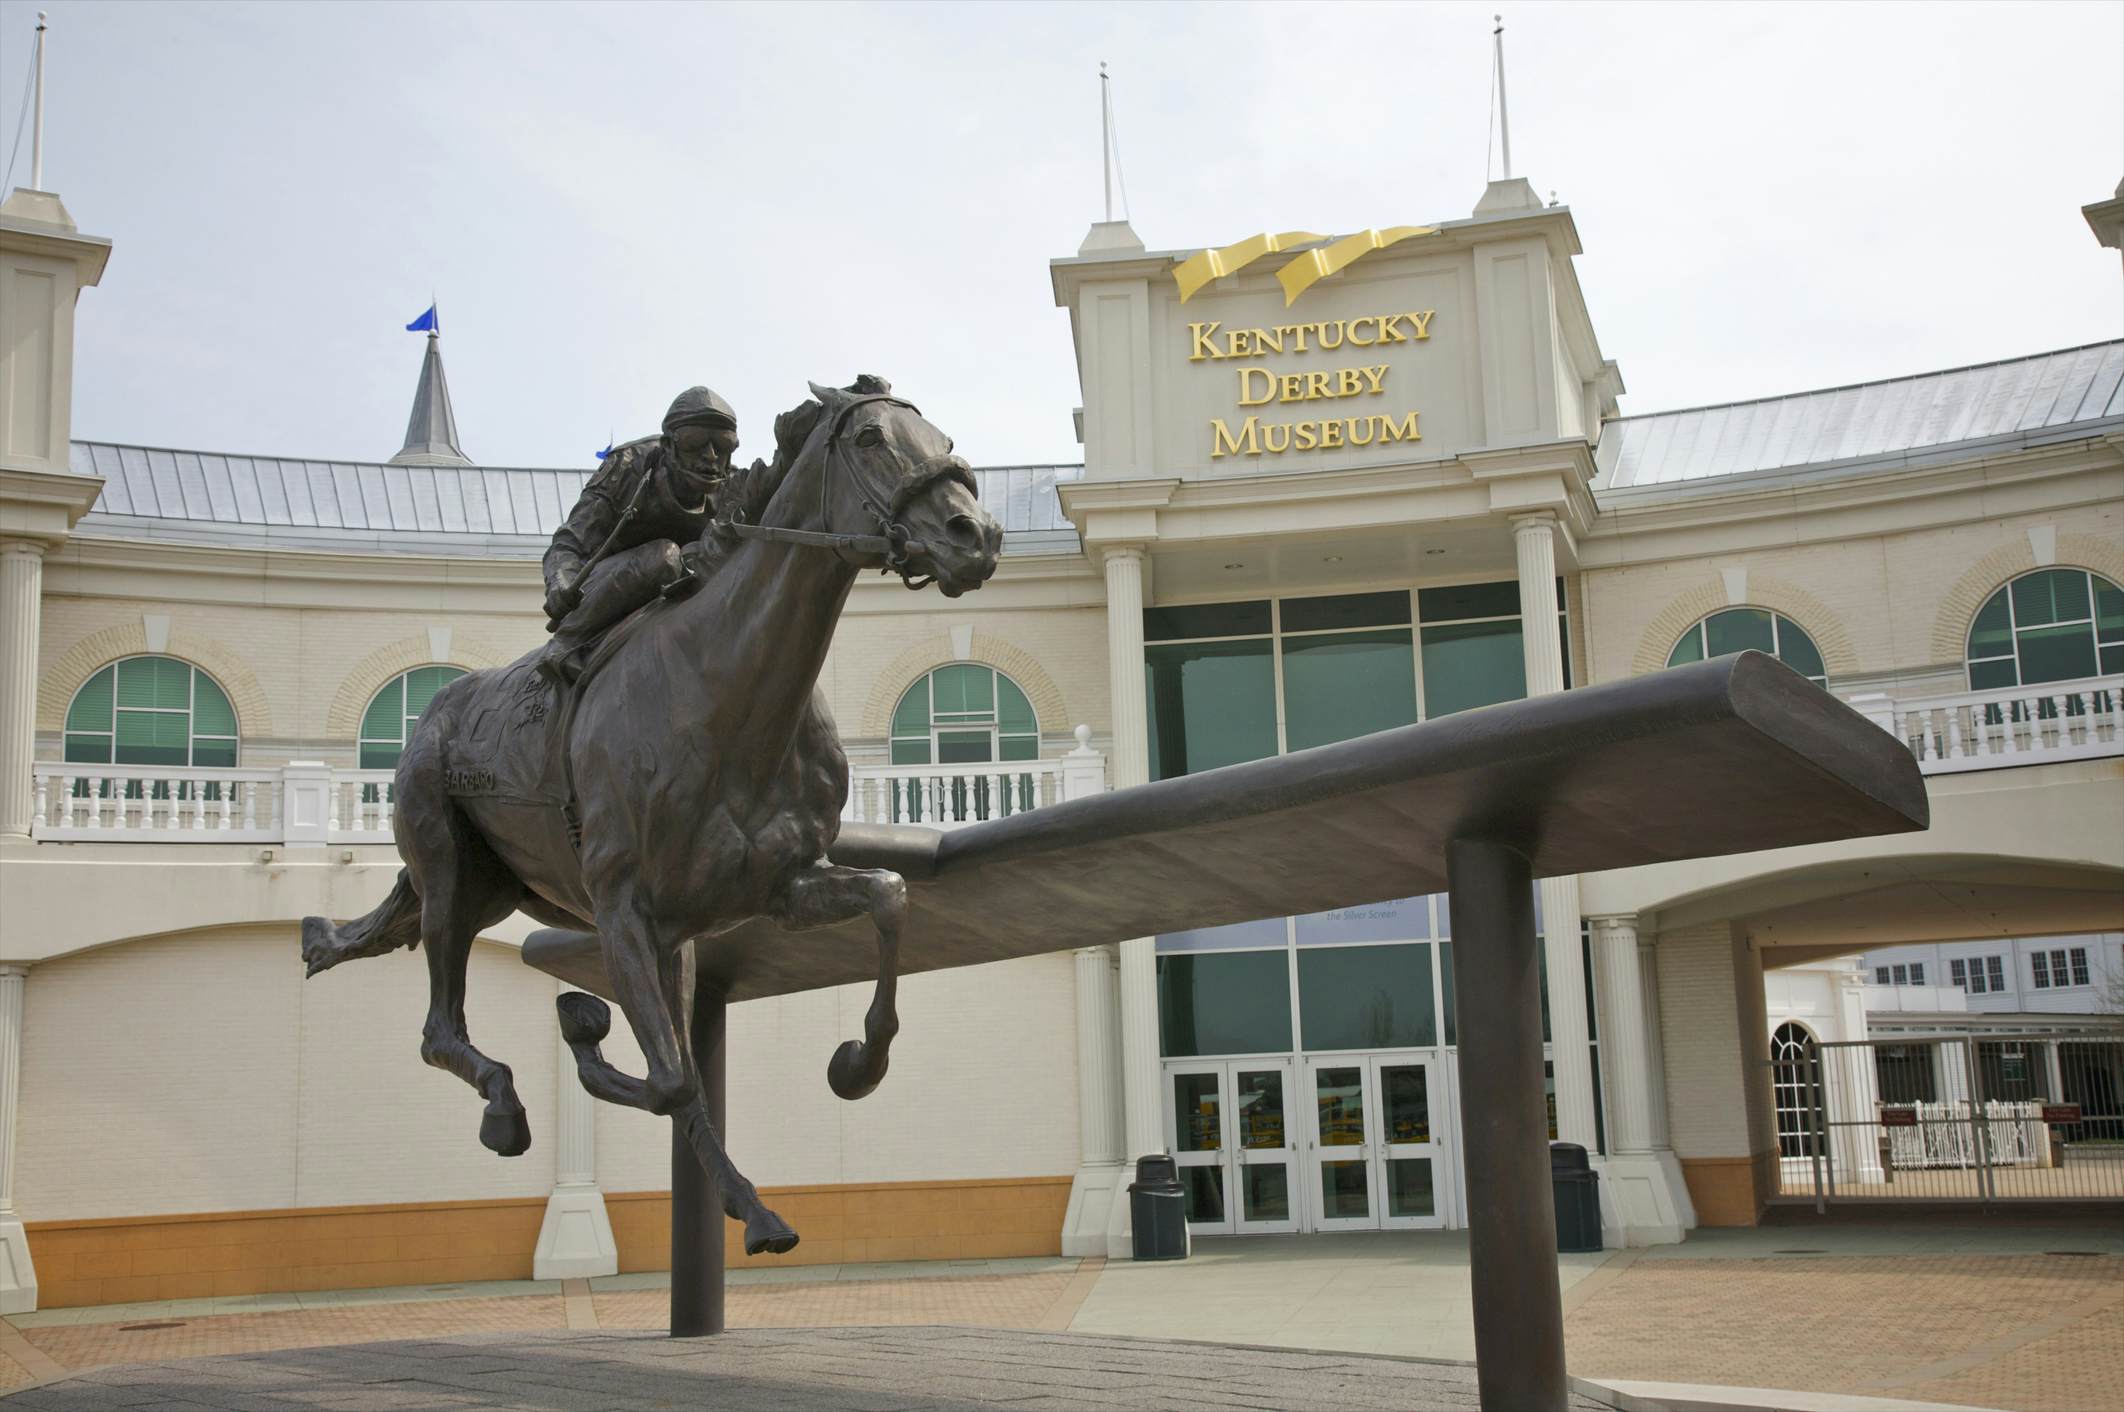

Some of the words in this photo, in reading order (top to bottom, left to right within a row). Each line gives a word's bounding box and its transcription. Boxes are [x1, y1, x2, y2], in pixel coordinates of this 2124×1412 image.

[1187, 309, 1436, 362] KENTUCKY
[1237, 364, 1391, 408] DERBY
[1210, 411, 1422, 459] MUSEUM
[1327, 911, 1341, 921] the
[1343, 910, 1367, 921] Silver
[1368, 910, 1397, 920] Screen
